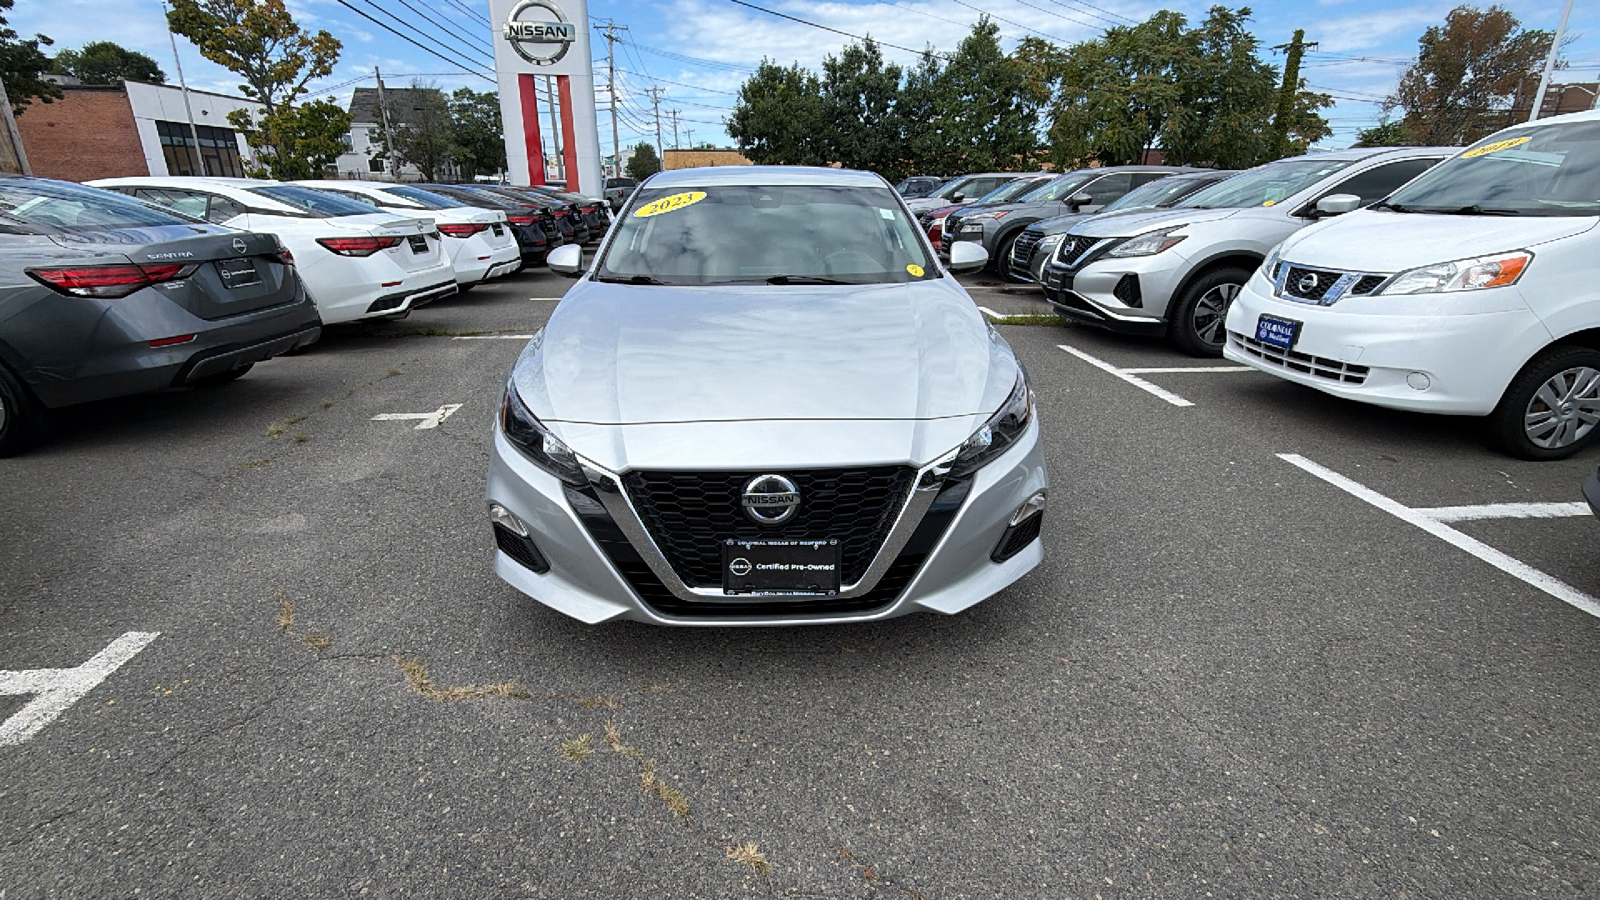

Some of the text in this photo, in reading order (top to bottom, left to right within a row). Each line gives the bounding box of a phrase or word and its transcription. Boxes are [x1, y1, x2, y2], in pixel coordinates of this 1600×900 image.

[509, 25, 568, 38] NISSAN
[648, 193, 694, 214] 2023
[147, 251, 194, 260] SENTRA
[1260, 321, 1293, 336] COLONIAL
[1268, 332, 1290, 344] Medford
[747, 494, 794, 504] NISSAN
[756, 563, 835, 571] Certified Pre-Owned
